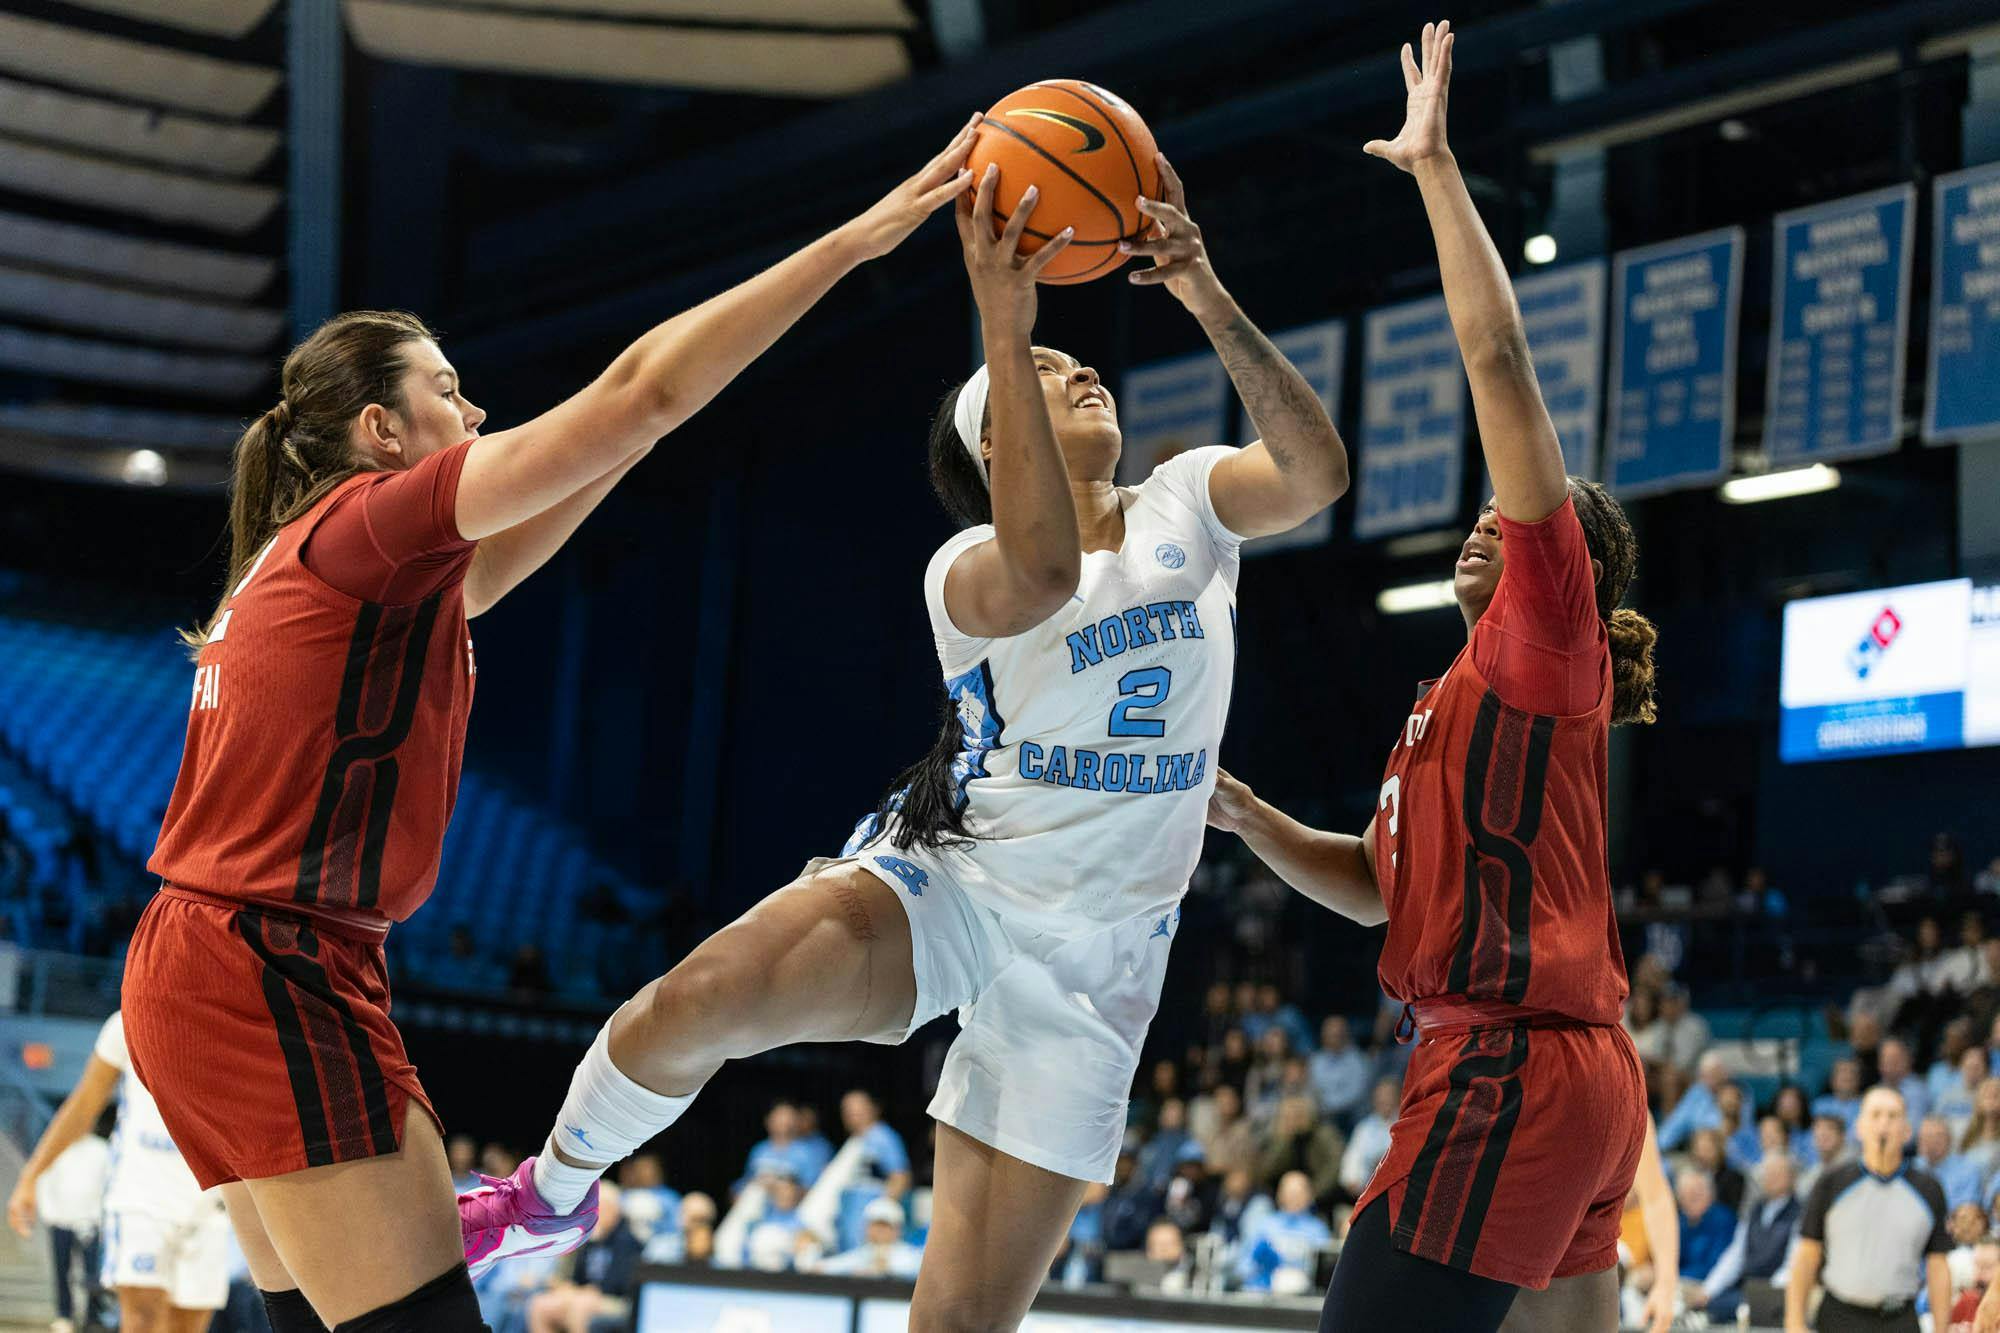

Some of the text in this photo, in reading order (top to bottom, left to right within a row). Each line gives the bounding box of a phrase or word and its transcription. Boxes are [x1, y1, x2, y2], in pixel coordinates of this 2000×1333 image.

[1066, 600, 1205, 675] NORTH
[1108, 665, 1172, 738] 2
[1018, 740, 1207, 794] CAROLINA
